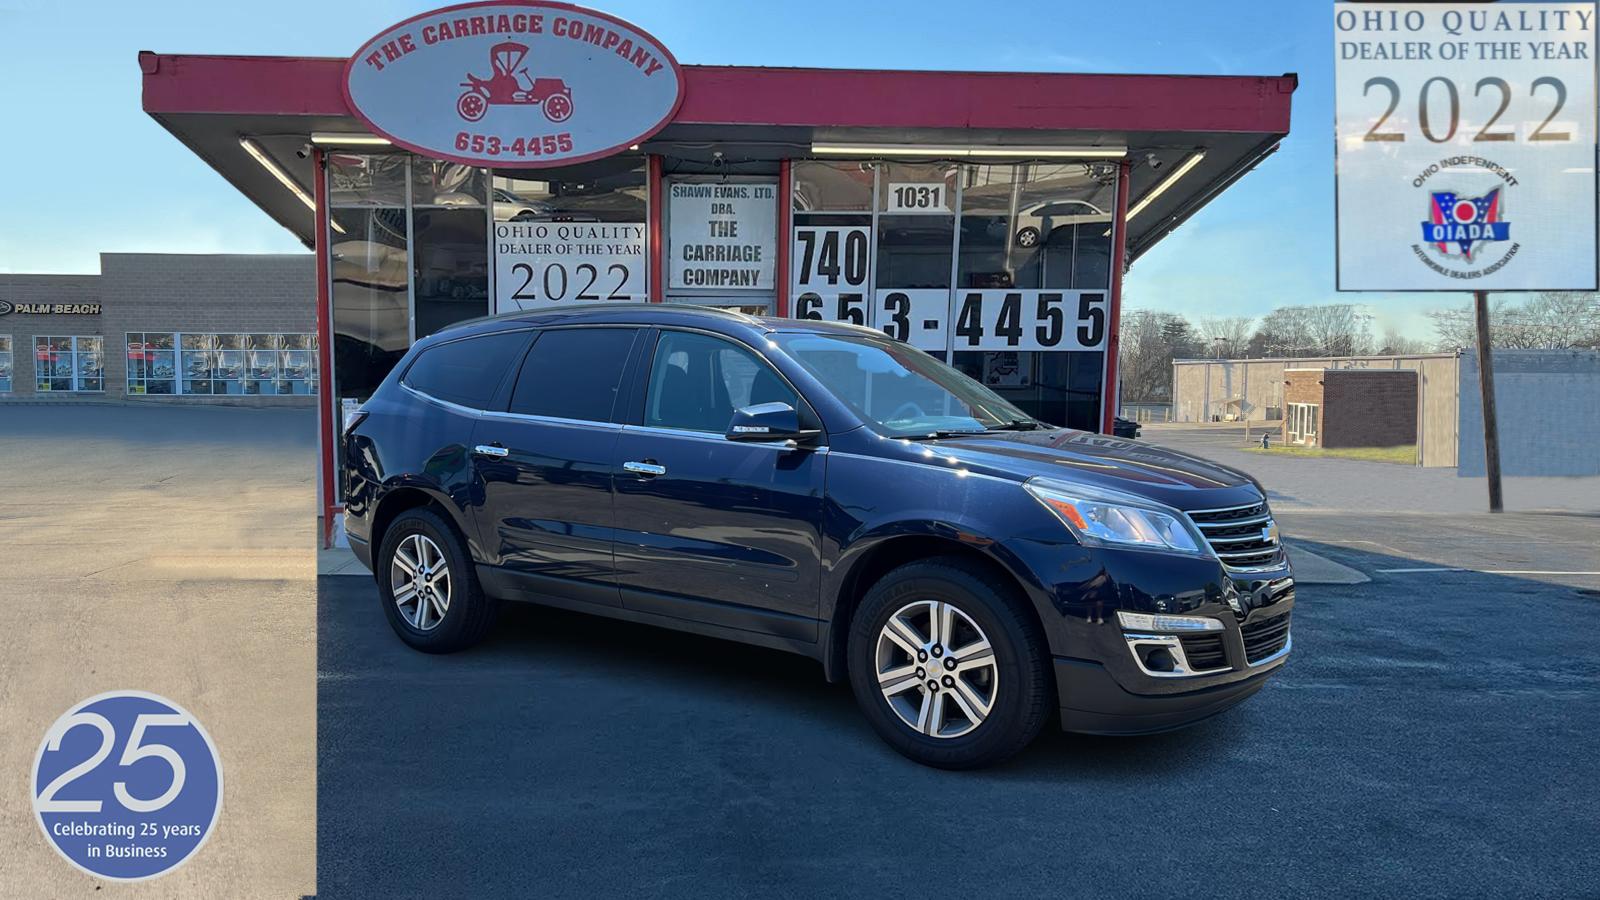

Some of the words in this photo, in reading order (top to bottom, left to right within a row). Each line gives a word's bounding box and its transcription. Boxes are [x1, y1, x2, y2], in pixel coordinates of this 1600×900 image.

[1336, 10, 1425, 32] OHIO
[1442, 10, 1592, 36] QUALITY
[365, 33, 417, 71] THE
[422, 14, 544, 46] CARRIAGE
[552, 17, 665, 77] COMPANY
[1340, 42, 1433, 60] DEALER
[1439, 42, 1469, 60] OF
[1474, 42, 1521, 60] THE
[1527, 42, 1589, 60] YEAR
[1362, 76, 1570, 143] 2022
[455, 131, 573, 157] 653-4455
[1412, 164, 1439, 188] OHIO
[1440, 156, 1519, 187] INDEPENDENT
[672, 186, 712, 199] SHAWN
[754, 187, 774, 199] LTD.
[894, 187, 940, 208] 1031
[711, 203, 735, 215] DBA.
[497, 226, 548, 239] OHIO
[557, 226, 644, 241] QUALITY
[708, 220, 738, 238] THE
[1432, 224, 1495, 240] OIADA
[499, 243, 552, 255] DEALER
[555, 243, 573, 255] OF
[576, 243, 603, 255] THE
[606, 243, 641, 255] YEAR
[683, 244, 762, 262] CARRIAGE
[797, 230, 868, 286] 740
[1411, 244, 1449, 277] AUTOMOBILE
[1449, 270, 1482, 279] DEALERS
[1482, 242, 1520, 276] ASSOCIATION
[511, 263, 631, 301] 2022
[683, 268, 760, 286] COMPANY
[15, 304, 50, 314] PALM
[55, 304, 100, 314] BEACH
